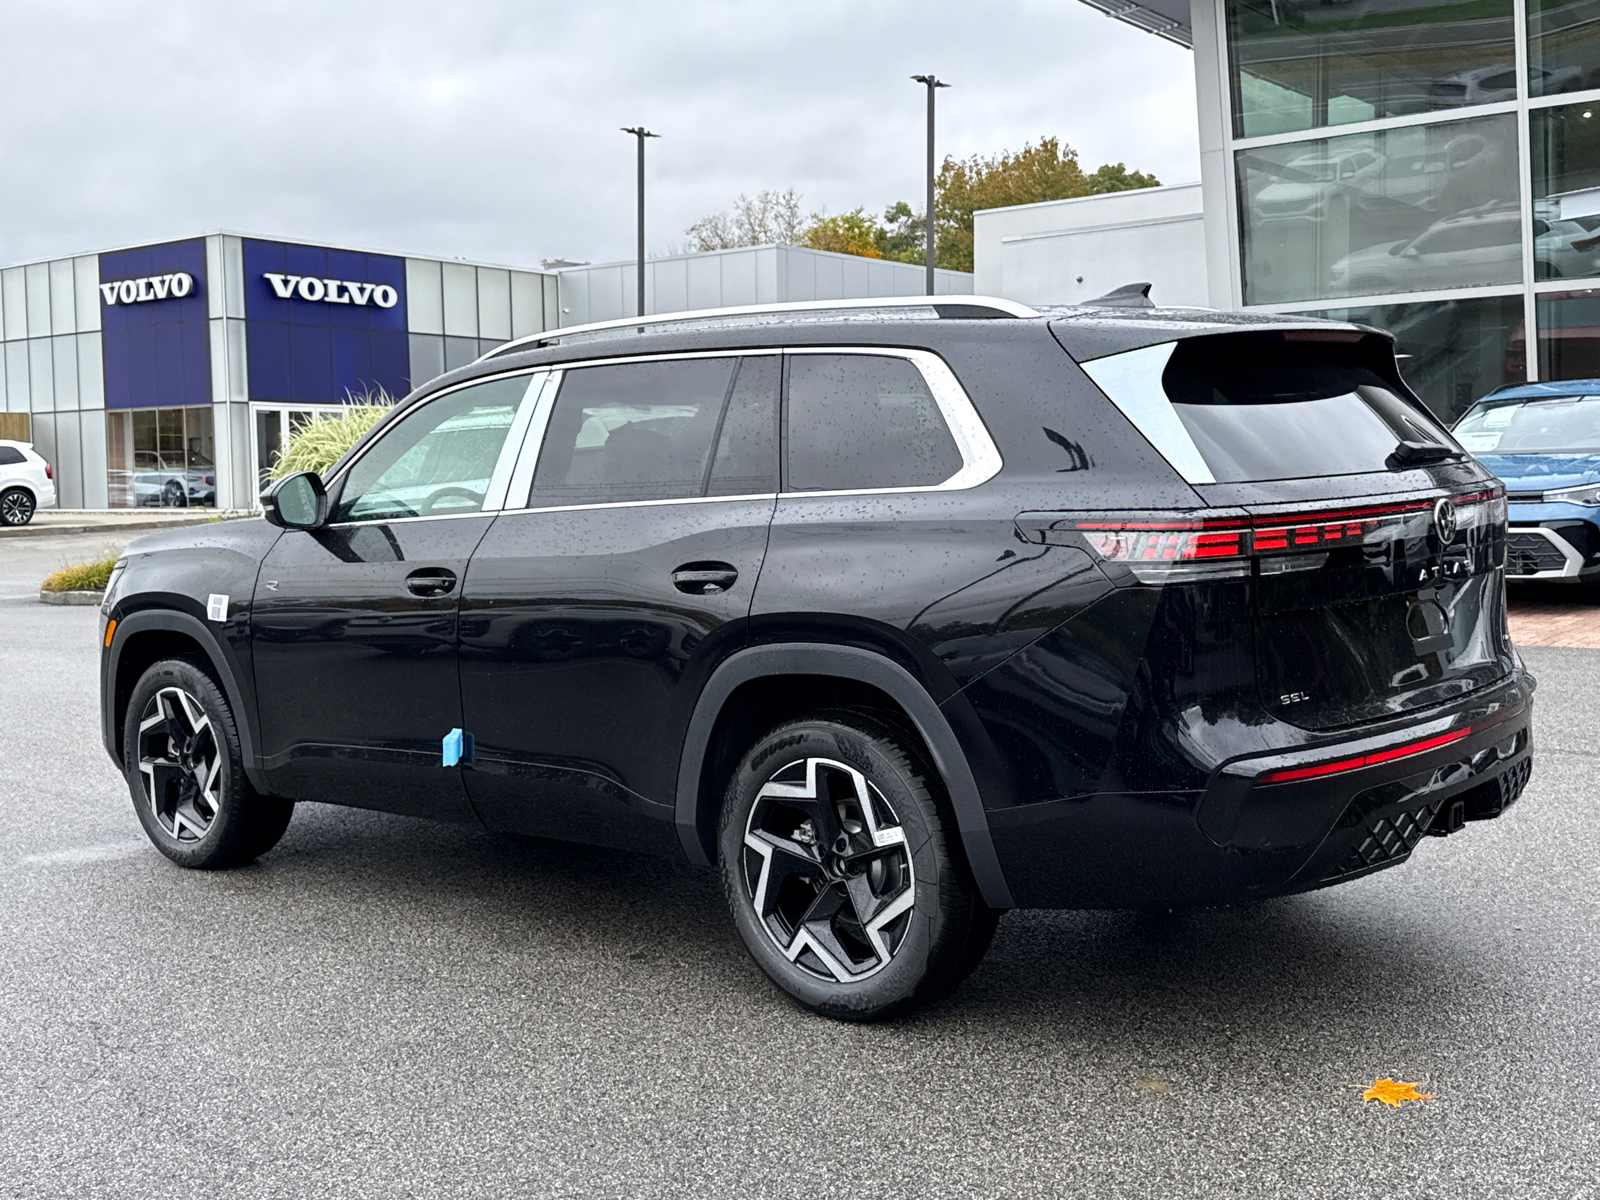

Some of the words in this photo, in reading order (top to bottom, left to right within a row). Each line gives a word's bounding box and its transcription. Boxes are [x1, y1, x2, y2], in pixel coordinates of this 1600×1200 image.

[99, 272, 193, 306] VOLVO
[264, 272, 398, 308] VOLVO
[1280, 691, 1310, 705] SEL
